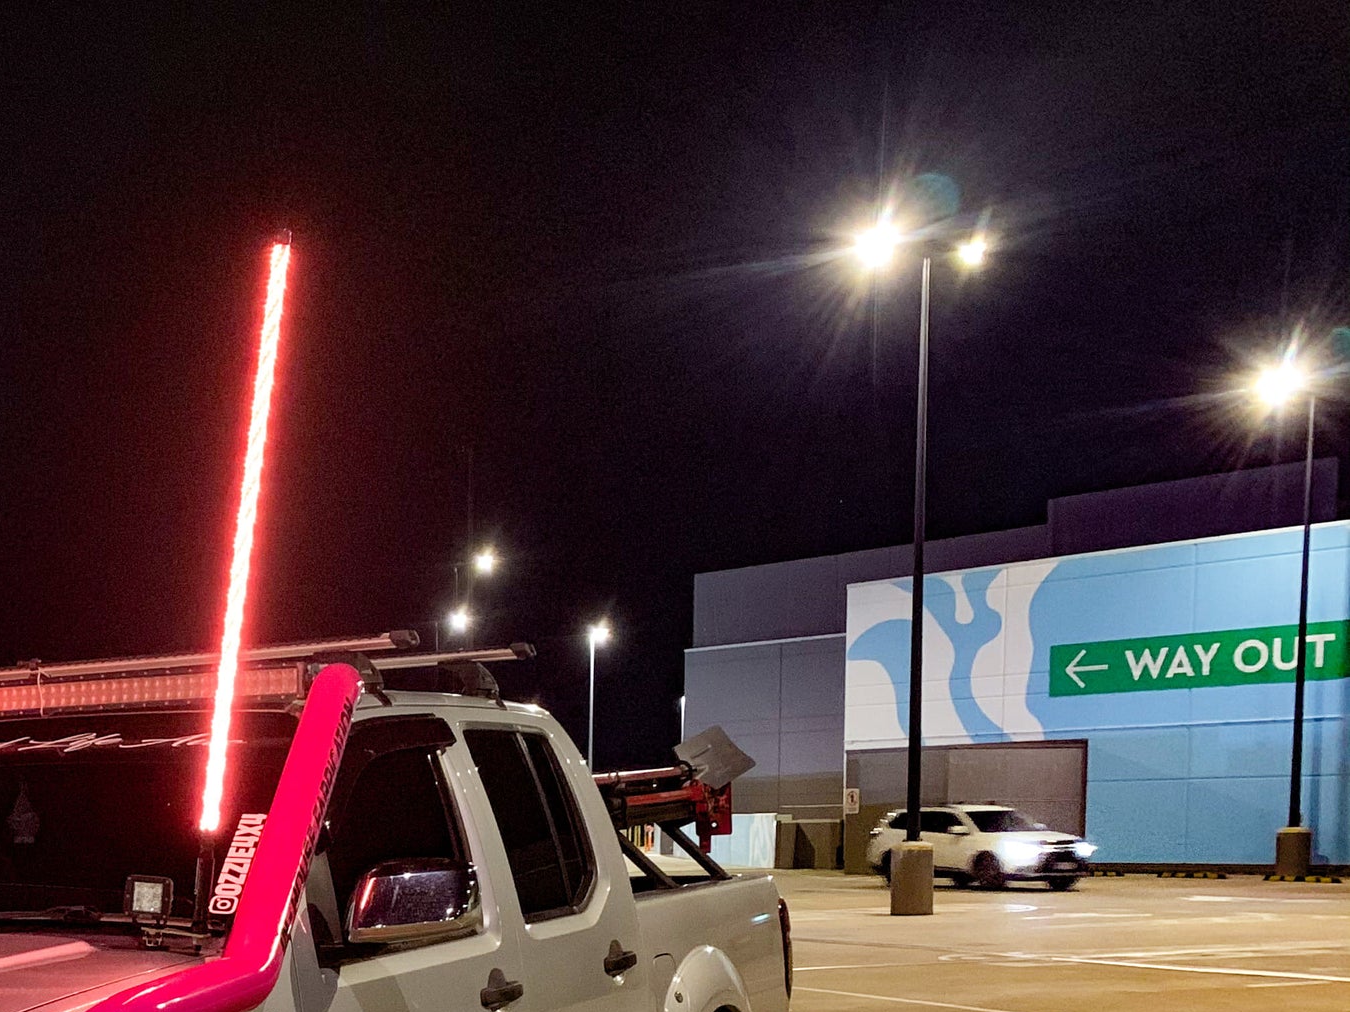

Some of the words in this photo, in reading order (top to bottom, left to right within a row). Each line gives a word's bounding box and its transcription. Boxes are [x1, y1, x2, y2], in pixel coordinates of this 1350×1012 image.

[1125, 643, 1221, 681] WAY
[1233, 633, 1337, 673] OUT
[214, 813, 268, 897] OZZIE4X4
